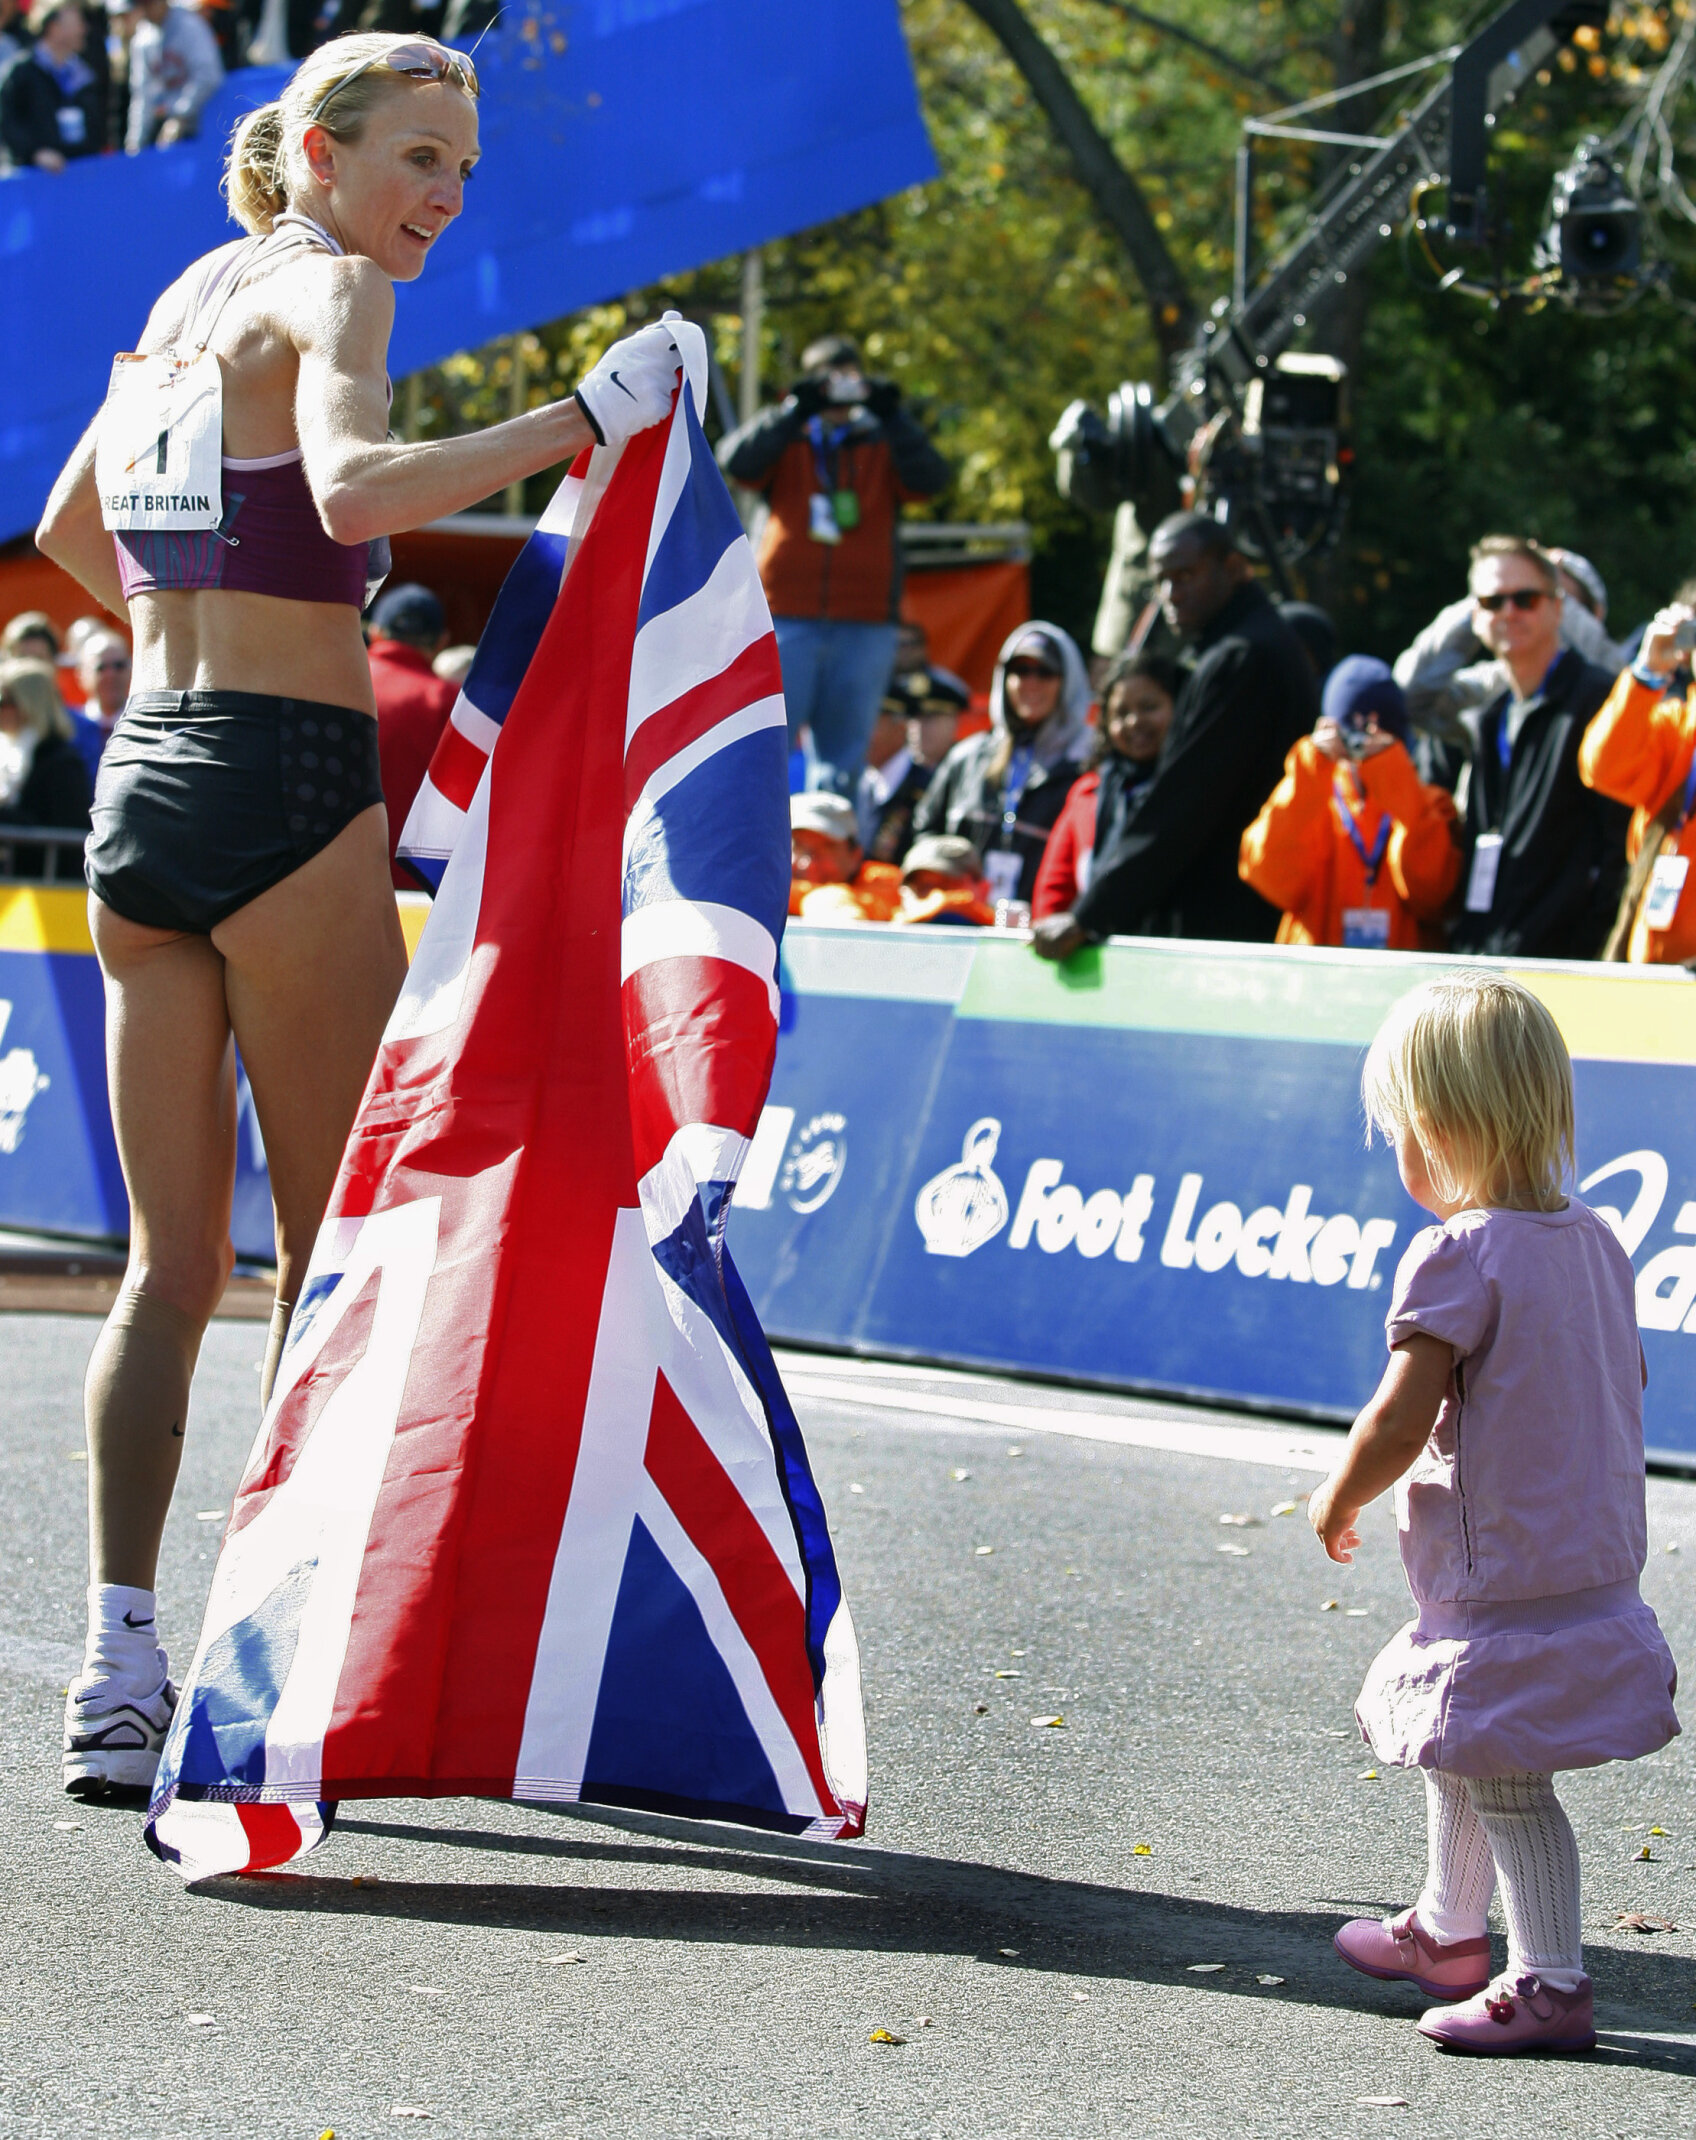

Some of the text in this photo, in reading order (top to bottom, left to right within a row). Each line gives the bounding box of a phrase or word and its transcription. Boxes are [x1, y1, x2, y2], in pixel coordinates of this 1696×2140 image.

[156, 429, 169, 475] 1
[100, 495, 211, 512] REAT BRITAIN
[1008, 1158, 1397, 1290] Foot Locker
